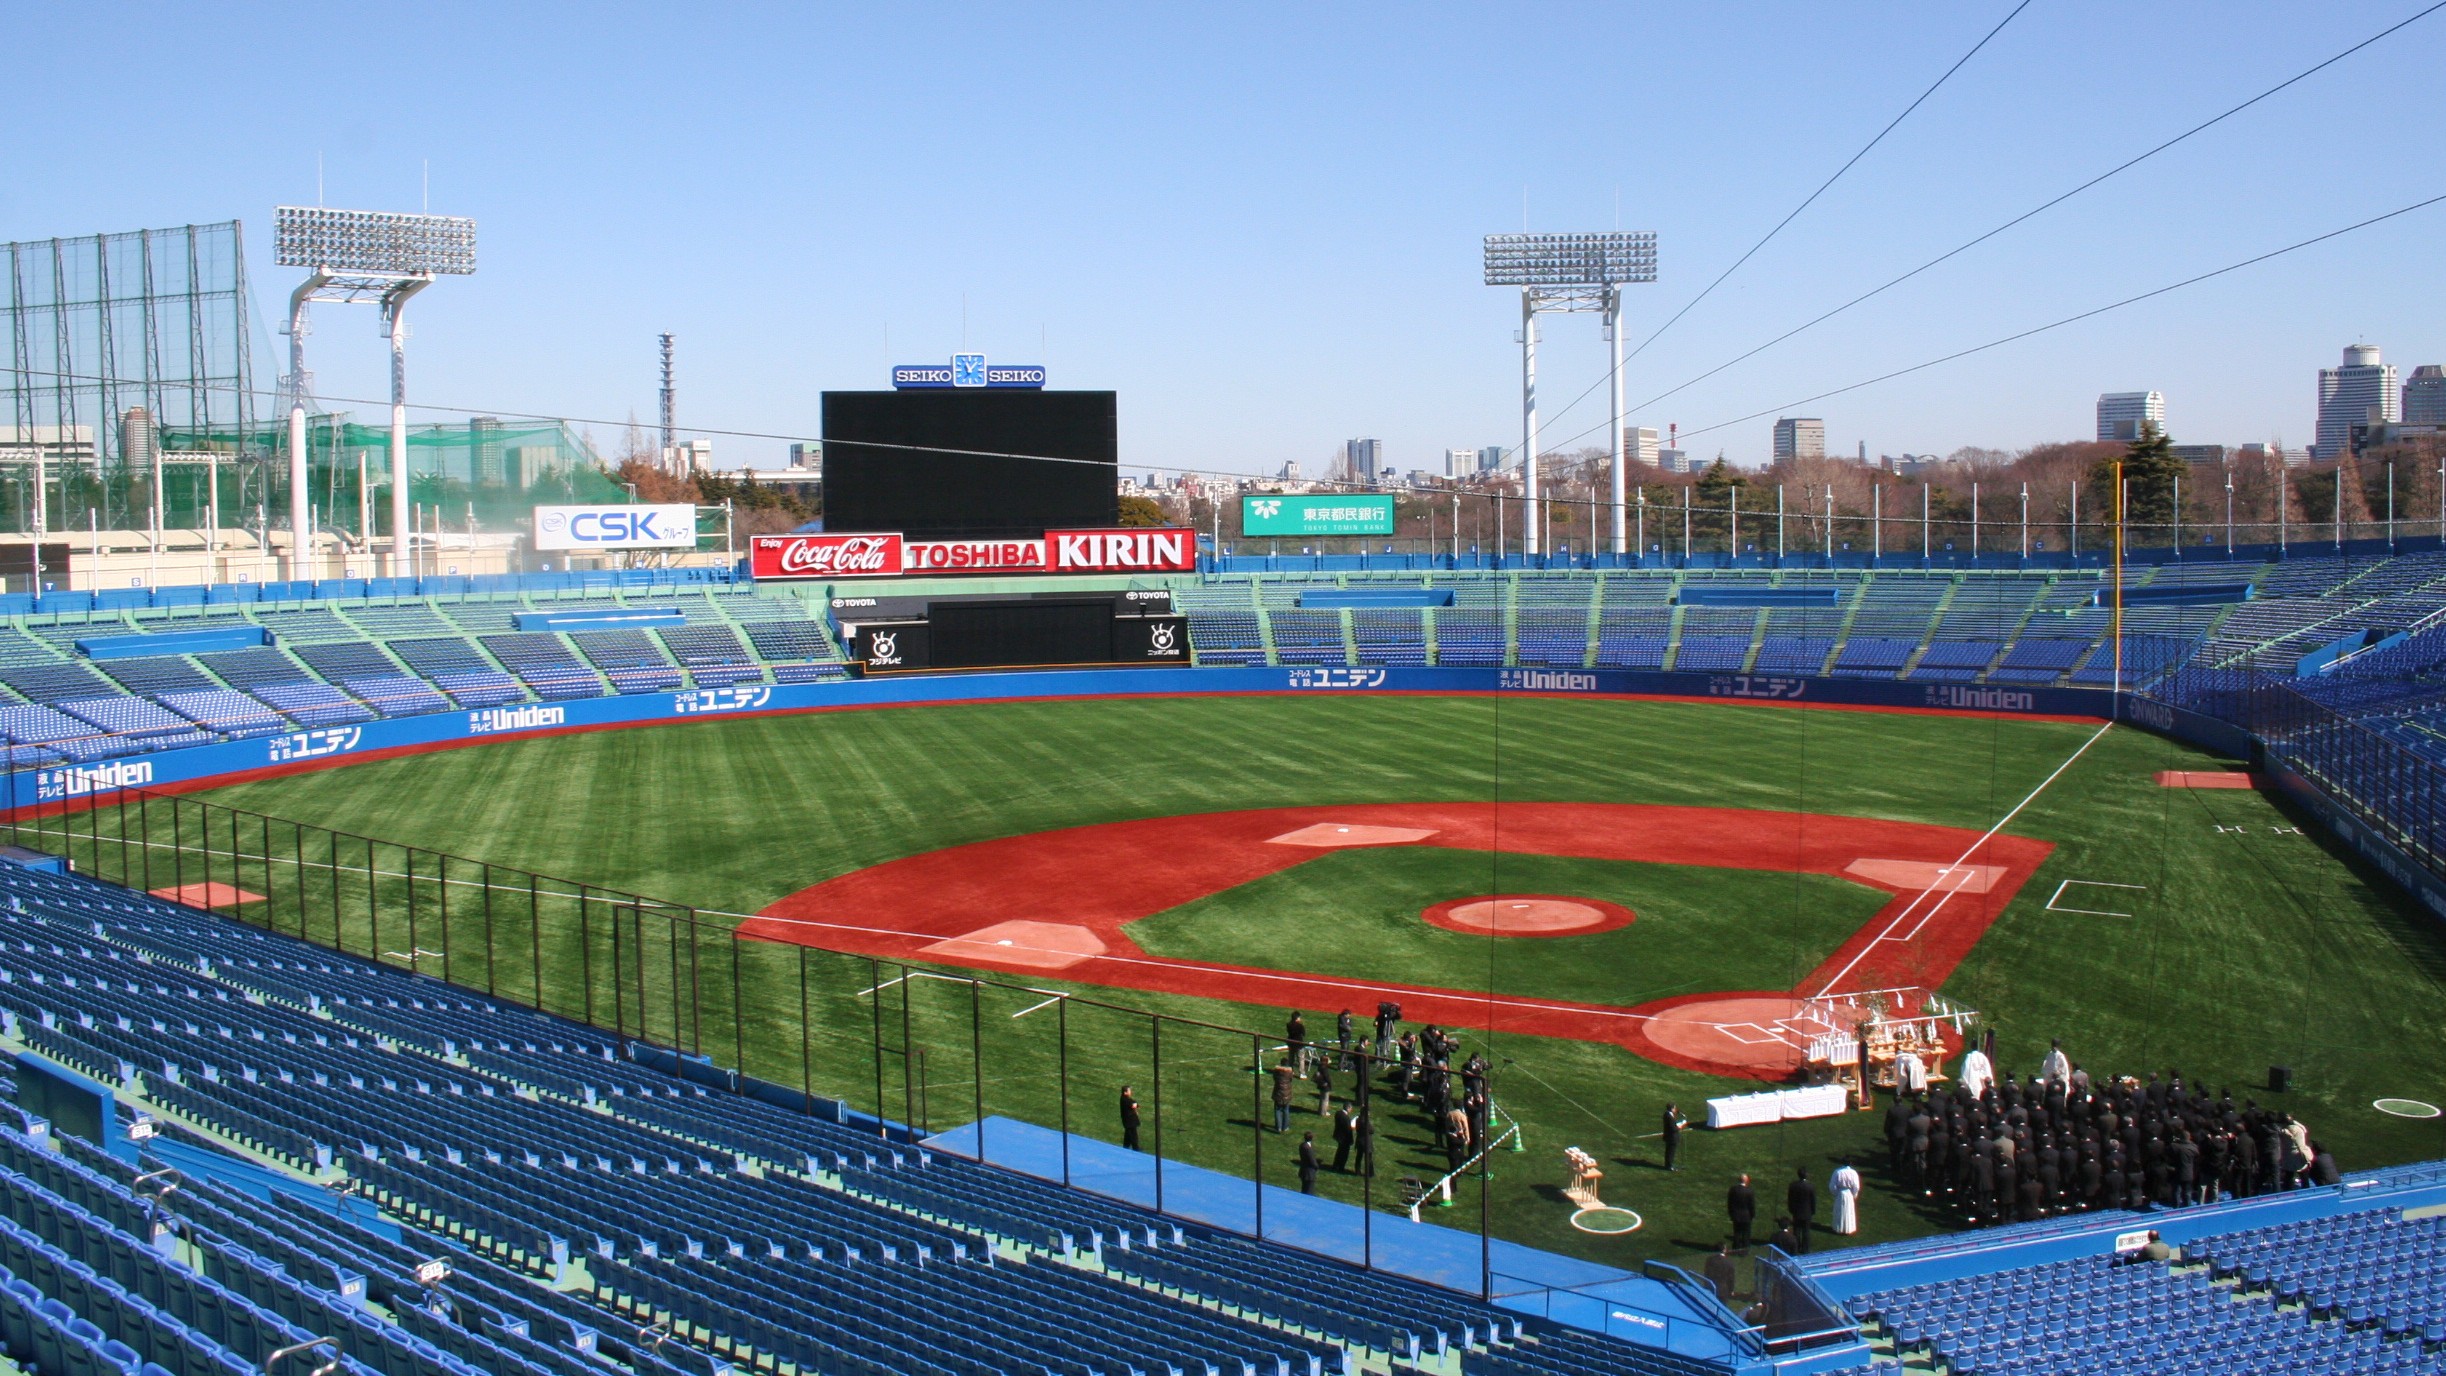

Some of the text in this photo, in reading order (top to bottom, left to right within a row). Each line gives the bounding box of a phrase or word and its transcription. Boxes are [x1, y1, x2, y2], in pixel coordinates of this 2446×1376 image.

[896, 370, 1044, 382] SEIKO SEIKO
[1303, 507, 1386, 521] 東京都民銀行
[570, 512, 662, 541] CSK
[662, 525, 690, 540] グループ
[760, 538, 783, 549] Enjoy
[1057, 534, 1183, 567] KIRIN
[781, 537, 889, 571] Coca-Cola
[909, 543, 1040, 567] TOSHIBA
[844, 598, 877, 606] TOYOTA
[1139, 591, 1170, 599] TOYOTA
[868, 656, 902, 665] フジテレビ
[1289, 669, 1311, 678] コードレス
[1312, 669, 1386, 687] ユニデン
[1523, 670, 1596, 690] Uniden
[1500, 679, 1522, 689] テレビ
[1733, 676, 1806, 698] ユニデン
[699, 687, 771, 711] ユニデン
[1950, 686, 2033, 709] Uniden
[492, 705, 565, 730] Uniden
[2128, 698, 2174, 730] ONWARD
[469, 721, 492, 733] テレビ
[292, 726, 362, 758] ユニデン
[66, 761, 153, 795] Uniden
[37, 784, 65, 799] テレビ
